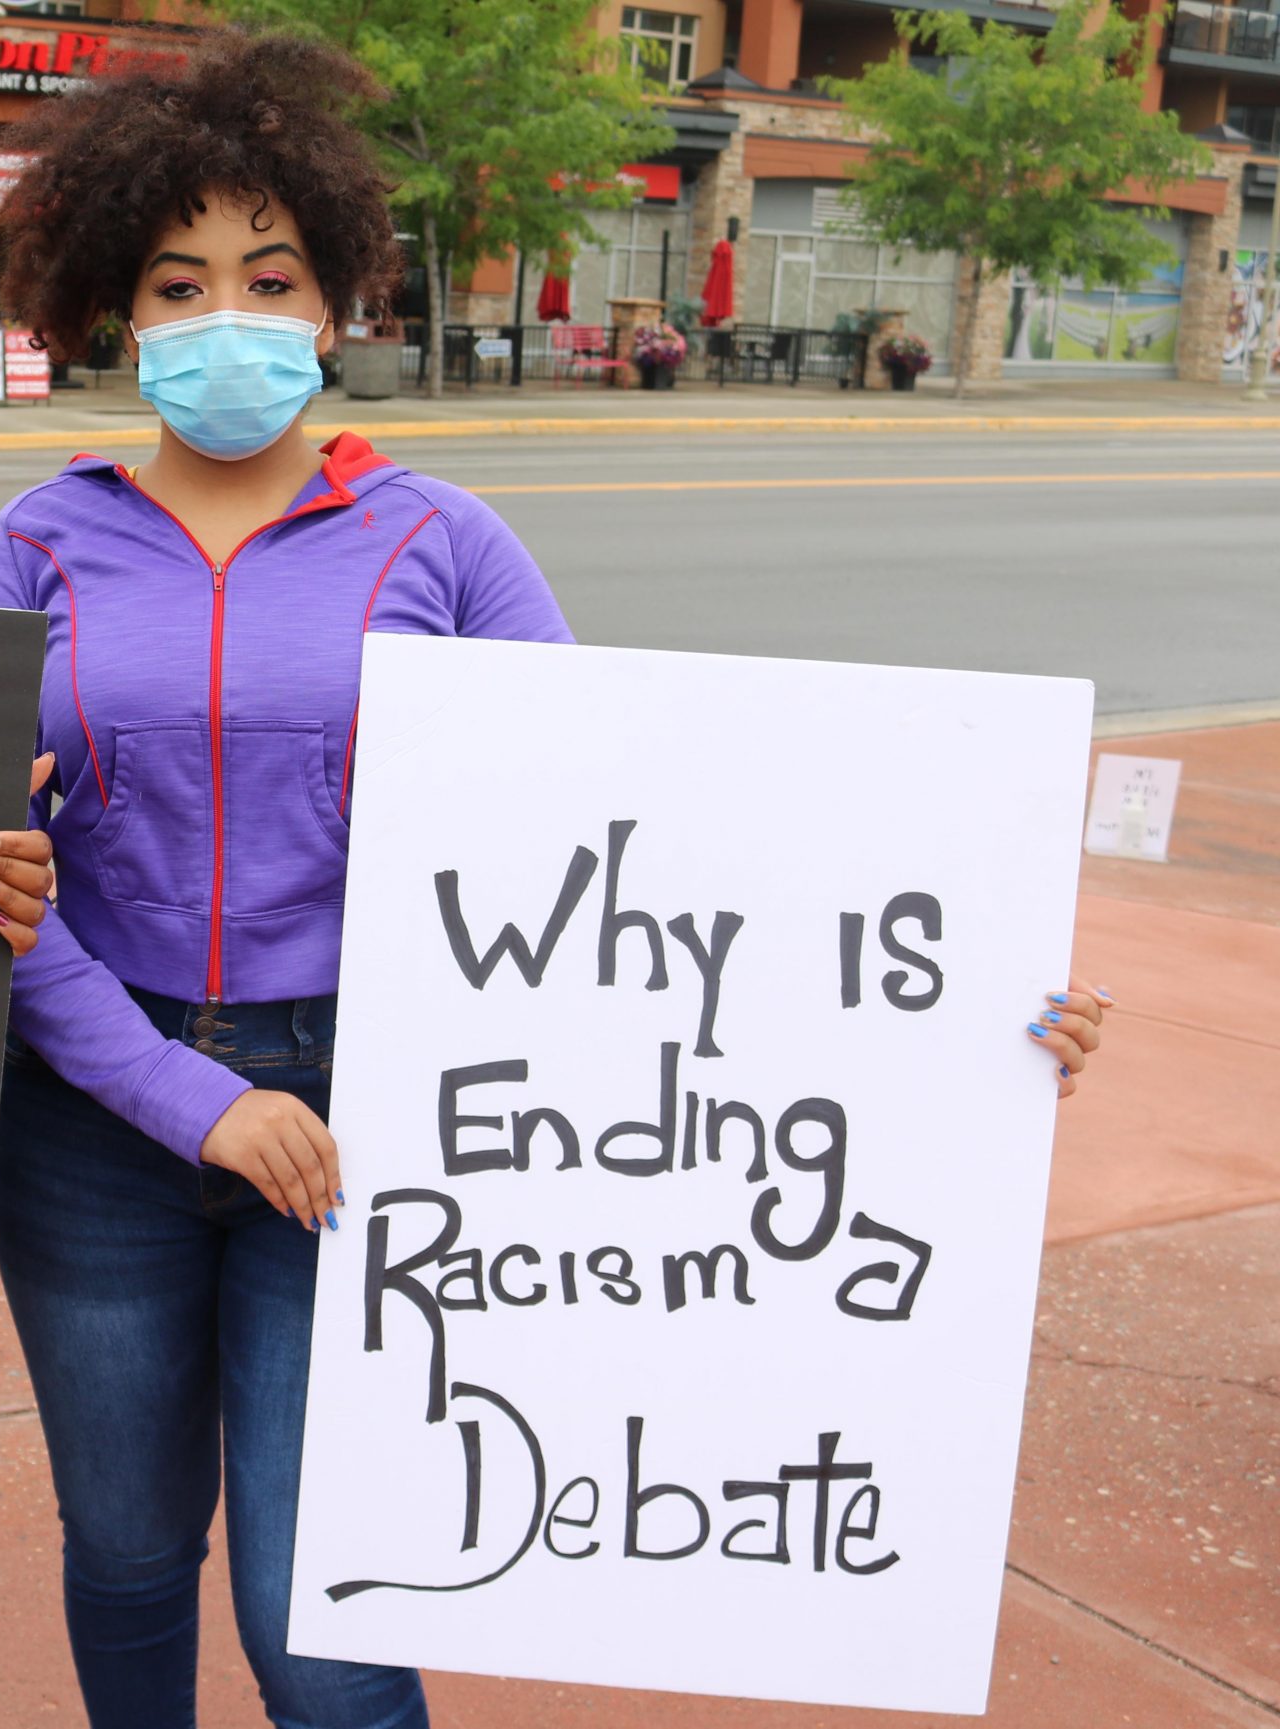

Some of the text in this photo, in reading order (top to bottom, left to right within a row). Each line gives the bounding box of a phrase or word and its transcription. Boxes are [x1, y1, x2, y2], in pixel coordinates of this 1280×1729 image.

[25, 75, 37, 92] &
[39, 76, 97, 93] SPORT
[434, 819, 744, 1058] Why
[438, 1041, 847, 1261] Ending
[363, 1188, 933, 1424] Racism a
[325, 1381, 901, 1601] Debate
